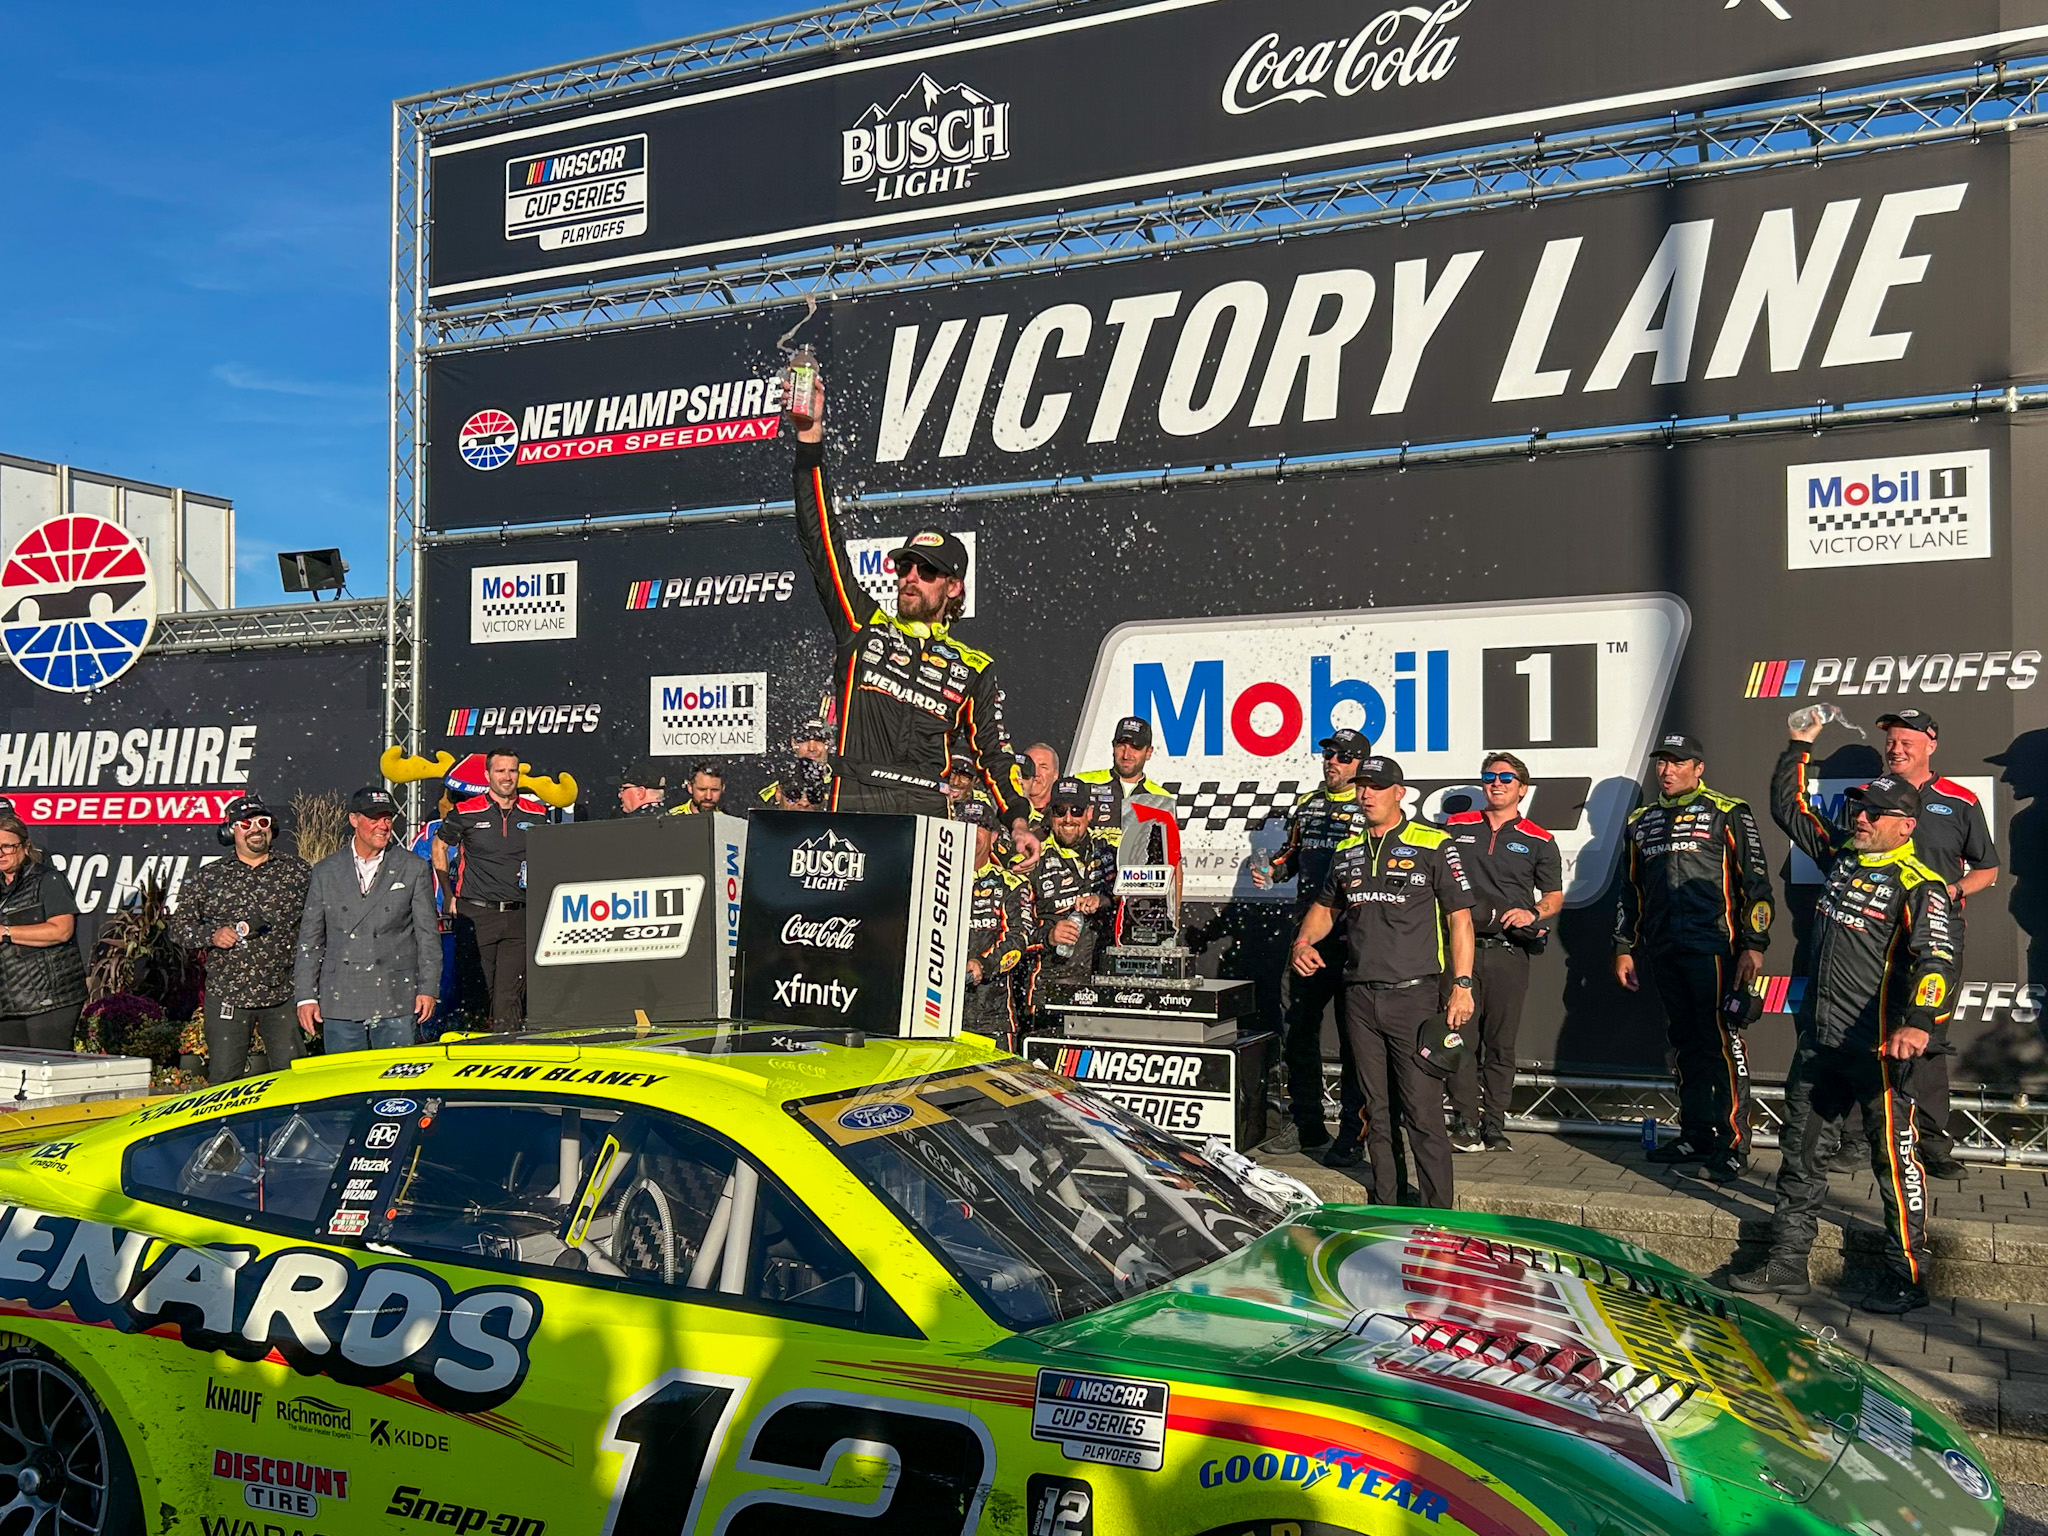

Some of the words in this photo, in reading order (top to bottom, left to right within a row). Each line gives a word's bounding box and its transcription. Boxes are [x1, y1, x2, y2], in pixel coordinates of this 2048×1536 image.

[1221, 0, 1472, 115] Coca-Cola
[840, 100, 1010, 186] BUSCH
[549, 145, 627, 182] NASCAR
[874, 166, 972, 203] LIGHT
[524, 191, 560, 221] CUP
[562, 181, 627, 213] SERIES
[560, 219, 626, 245] PLAYOFFS
[875, 249, 1485, 464] VICTORY
[1490, 182, 1969, 403] LANE
[521, 398, 596, 443] NEW
[595, 376, 784, 433] HAMPSHIRE
[520, 432, 622, 462] MOTOR
[624, 419, 777, 452] SPEEDWAY
[1808, 470, 1919, 509] Mobil
[1809, 533, 1903, 554] VICTORY
[1909, 529, 1968, 549] LANE
[482, 574, 541, 600] Mobil
[662, 570, 796, 609] PLAYOFFS
[482, 618, 533, 634] VICTORY
[534, 617, 566, 632] LANE
[1807, 650, 2042, 697] PLAYOFFS
[662, 685, 727, 711] Mobil
[863, 670, 948, 716] MENARDS
[1133, 649, 1449, 757] Mobil
[1513, 652, 1554, 743] 1
[478, 704, 602, 737] PLAYOFFS
[662, 731, 717, 747] VICTORY
[719, 730, 754, 745] LANE
[0, 725, 257, 787] HAMPSHIRE
[447, 778, 462, 789] NEW
[871, 769, 901, 781] RYAN
[900, 775, 938, 789] BLANEY
[31, 796, 241, 820] SPEEDWAY
[1641, 841, 1698, 858] MENARDS
[789, 848, 867, 883] BUSCH
[933, 825, 954, 928] SERIES
[1122, 869, 1154, 881] Mobil
[107, 855, 223, 916] MIL
[726, 843, 740, 948] Mobil
[802, 874, 848, 891] LIGHT
[1346, 891, 1407, 903] MENARDS
[562, 890, 648, 924] Mobil
[623, 925, 671, 940] 301
[780, 913, 860, 951] Coca-Cola
[927, 935, 947, 987] CUP
[772, 973, 859, 1014] xfinity
[1074, 991, 1099, 1002] BUSCH
[1114, 991, 1146, 1004] Coca-Cola
[1158, 993, 1193, 1008] xfinity
[453, 1064, 542, 1080] RYAN
[539, 1067, 671, 1088] BLANEY
[1087, 1050, 1203, 1087] NASCAR
[155, 1077, 279, 1119] ADVANCE
[190, 1103, 223, 1118] AUTO
[224, 1094, 262, 1113] PARTS
[380, 1100, 411, 1114] Ford
[853, 1104, 904, 1127] Ford
[368, 1125, 397, 1146] PPG
[31, 1142, 83, 1161] DEX
[349, 1156, 393, 1174] Mazak
[1899, 1124, 1923, 1212] DURACELL
[340, 1188, 378, 1201] WIZARD
[346, 1178, 374, 1190] DENT
[1076, 1380, 1149, 1408] NASCAR
[276, 1399, 352, 1431] Richmond
[1051, 1407, 1086, 1428] CUP
[1086, 1411, 1146, 1437] SERIES
[287, 1423, 299, 1431] The
[299, 1424, 314, 1434] Water
[314, 1427, 332, 1437] Heater
[332, 1430, 352, 1440] Experts
[394, 1428, 450, 1452] KIDDE
[602, 1370, 997, 1536] 12
[1082, 1444, 1142, 1465] PLAYOFFS
[212, 1448, 348, 1499] DISCOUNT
[1198, 1449, 1450, 1524] GOODYEAR
[251, 1487, 311, 1514] TIRE
[385, 1485, 548, 1536] Snap-on
[1037, 1499, 1046, 1510] OF
[1038, 1486, 1091, 1536] 12
